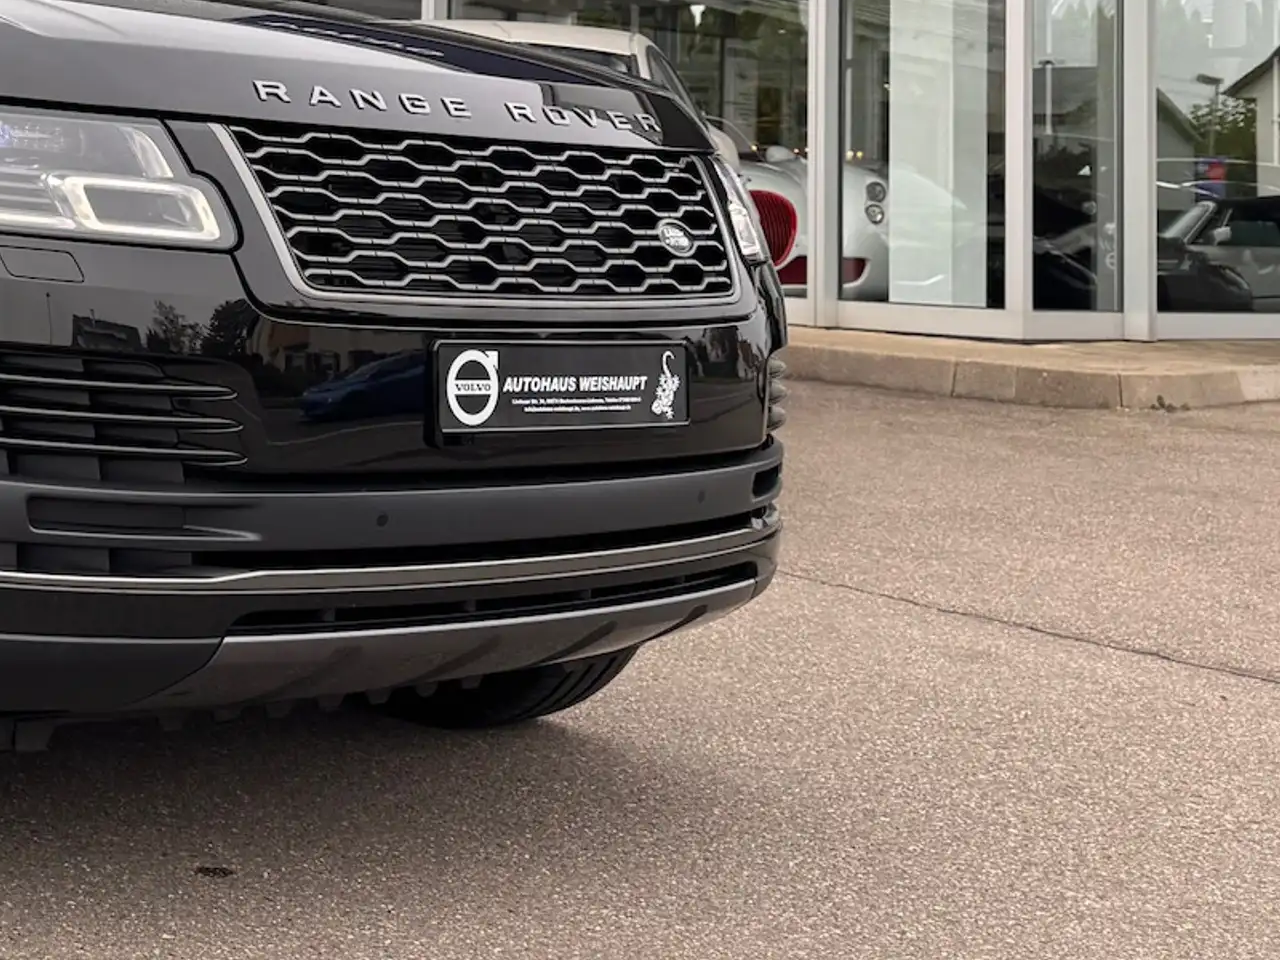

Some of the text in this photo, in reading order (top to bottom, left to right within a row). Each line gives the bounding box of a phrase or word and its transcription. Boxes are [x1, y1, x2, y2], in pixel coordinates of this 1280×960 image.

[252, 78, 663, 134] RANGE ROVER
[455, 382, 492, 392] VOLVO
[502, 375, 648, 393] AUTOHAUS WEISHAUPT
